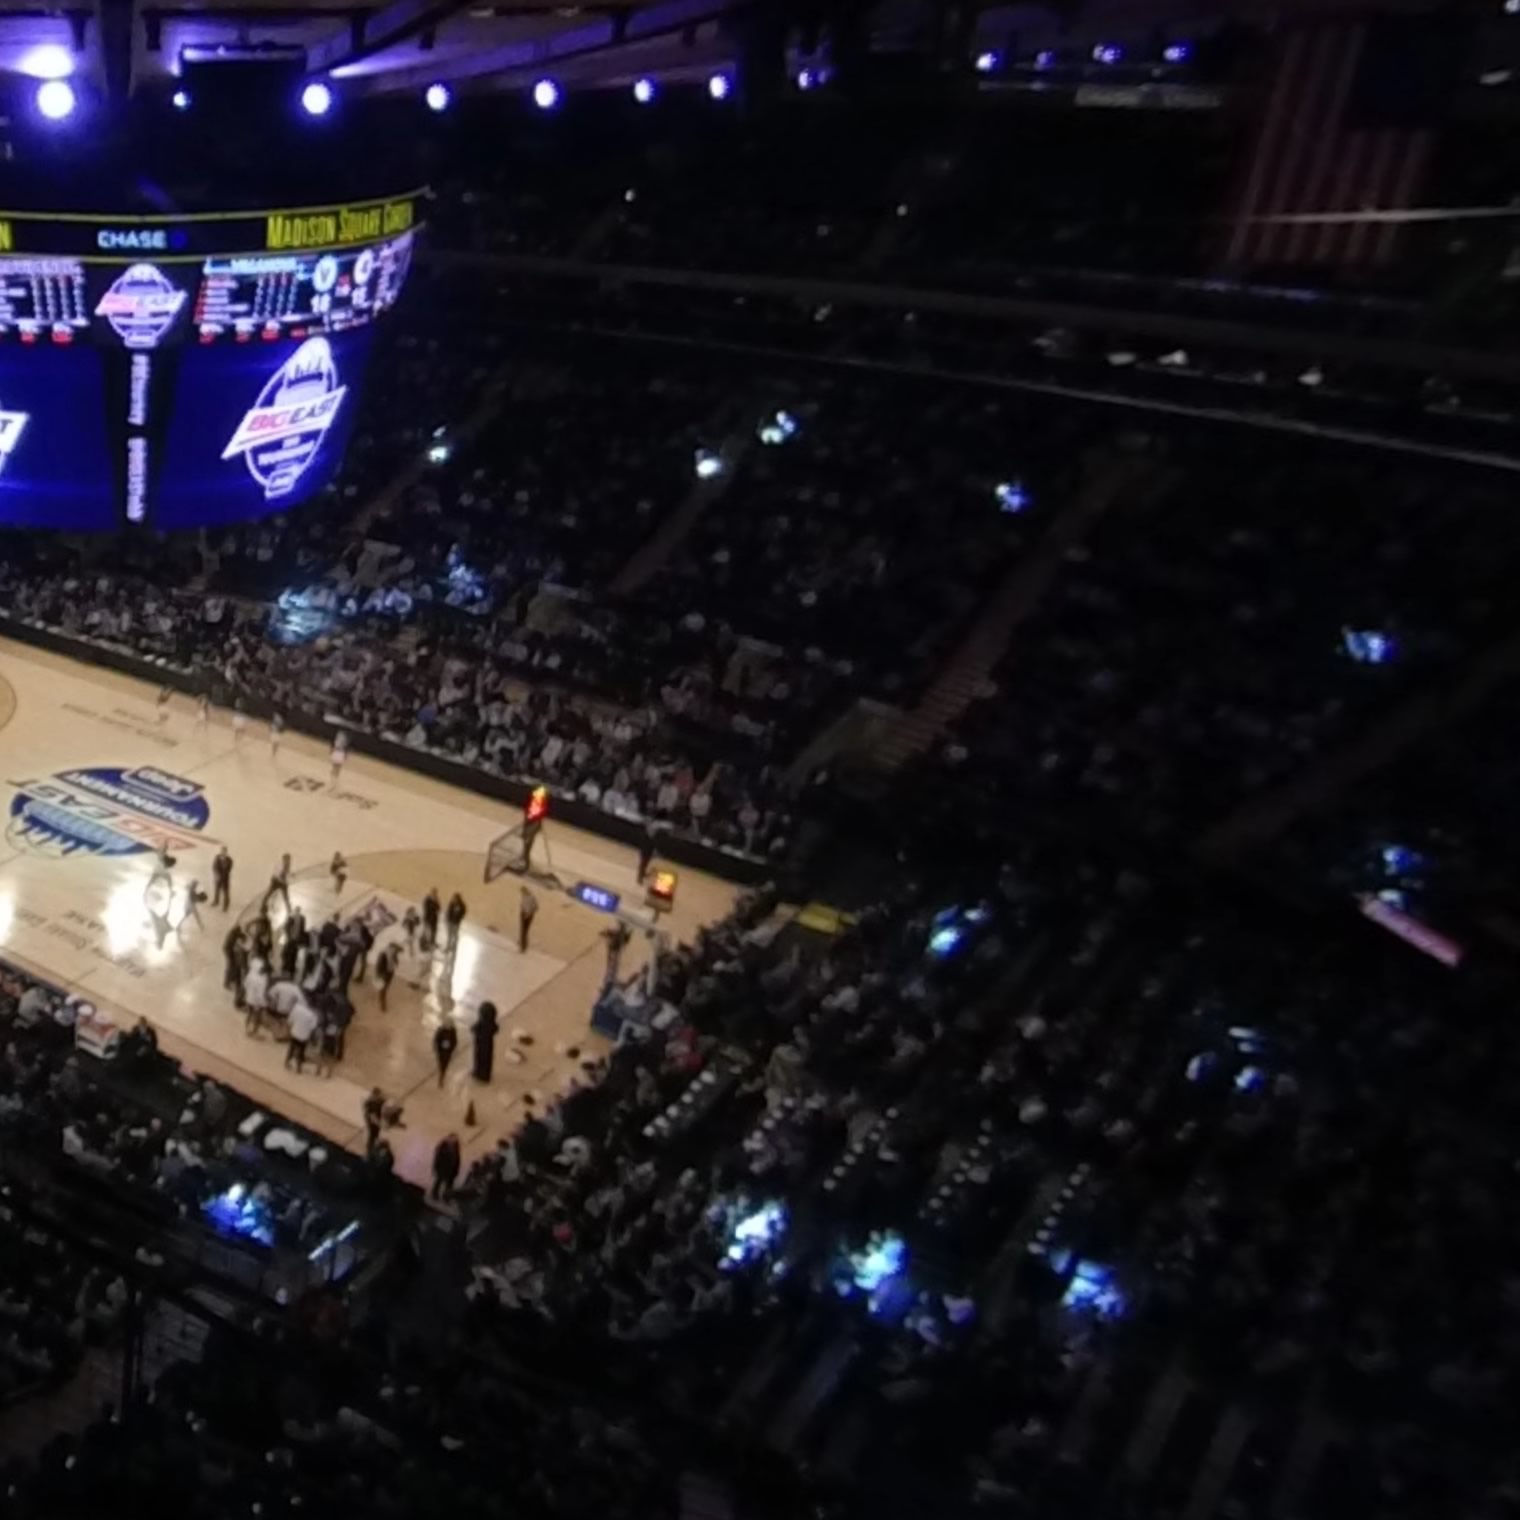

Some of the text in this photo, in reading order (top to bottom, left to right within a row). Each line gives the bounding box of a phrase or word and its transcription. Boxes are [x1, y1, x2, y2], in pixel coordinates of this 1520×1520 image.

[98, 230, 166, 248] CHASE
[267, 214, 336, 248] MADISON
[4, 779, 120, 818] EAST
[63, 772, 201, 827] TOURNAMENT
